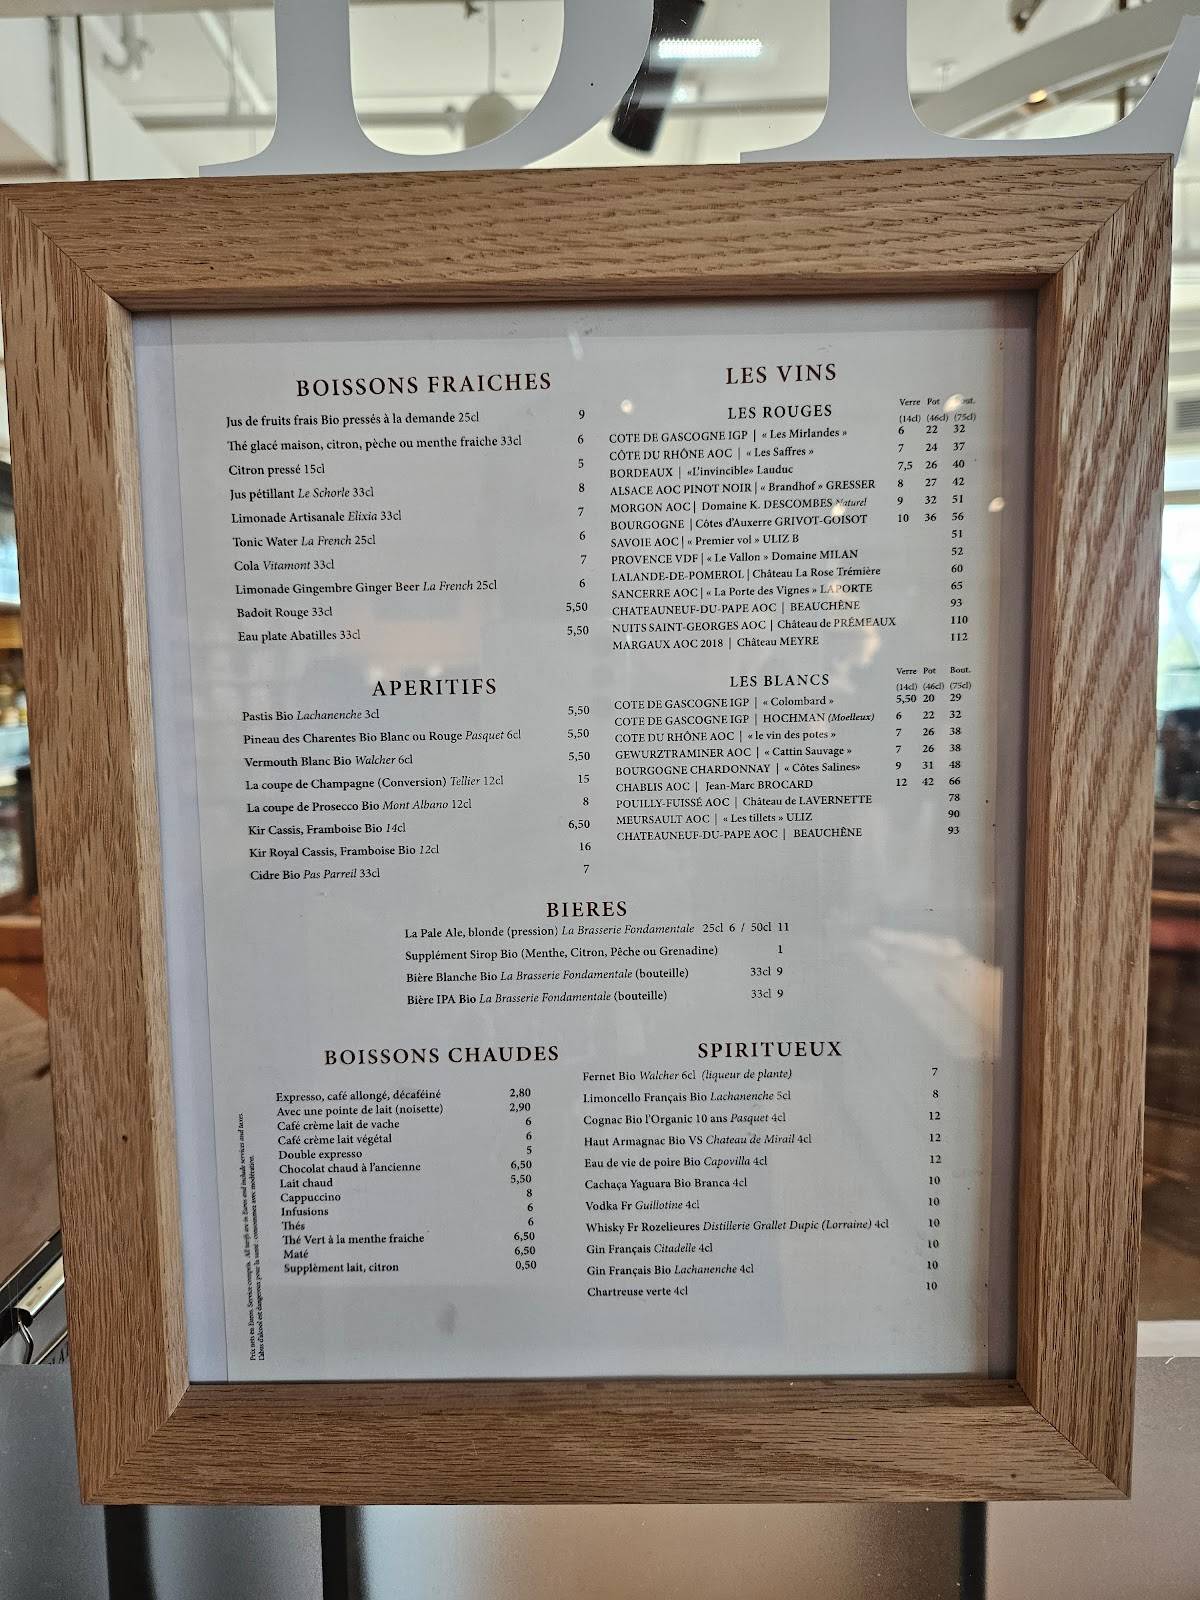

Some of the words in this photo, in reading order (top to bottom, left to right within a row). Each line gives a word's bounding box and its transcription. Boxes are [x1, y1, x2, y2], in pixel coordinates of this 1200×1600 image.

[726, 366, 767, 385] LES
[776, 363, 836, 383] VINS
[296, 376, 418, 397] BOISSONS
[427, 372, 551, 393] FRAICHES
[226, 416, 243, 429] Jus
[245, 415, 259, 427] de
[261, 415, 291, 426] fruits
[293, 414, 319, 426] frais
[320, 414, 340, 425] Bio
[342, 413, 381, 428] pressés
[383, 413, 390, 424] à
[392, 412, 403, 424] la
[405, 411, 456, 424] demande
[458, 411, 479, 423] 25cl
[578, 409, 585, 420] 9
[727, 406, 756, 420] LES
[762, 404, 832, 419] ROUGES
[228, 464, 265, 476] Citron
[267, 463, 301, 478] pressé
[304, 463, 325, 474] 15cl
[578, 458, 584, 469] 5
[231, 512, 287, 524] Limonade
[289, 511, 345, 523] Artisanale
[347, 510, 377, 522] Elixia
[380, 509, 402, 521] 33cl
[577, 506, 584, 517] 7
[234, 560, 261, 571] Cola
[262, 560, 311, 571] Vitamont
[313, 558, 335, 570] 33cl
[580, 554, 587, 565] 7
[612, 569, 745, 582] LALANDE-DE-POMEROL
[752, 568, 793, 579] Château
[795, 568, 808, 578] La
[810, 567, 834, 577] Rose
[836, 566, 881, 577] Trémière
[951, 563, 964, 574] 60
[236, 607, 273, 618] Badoit
[274, 607, 309, 620] Rouge
[312, 606, 333, 617] 33cl
[565, 602, 588, 613] 5,50
[612, 603, 750, 616] CHATEAUNEUF-DU-PAPE
[751, 602, 777, 613] AOC
[790, 599, 860, 611] BEAUCHÊNE
[950, 598, 963, 608] 93
[612, 639, 671, 650] MARGAUX
[673, 639, 698, 649] AOC
[700, 638, 724, 648] 2018
[736, 637, 777, 647] Château
[779, 636, 819, 646] MEYRE
[951, 632, 968, 642] 112
[896, 667, 918, 675] Verre
[923, 666, 937, 675] Pot
[371, 678, 496, 697] APERITIFS
[730, 675, 758, 688] LES
[763, 673, 829, 687] BLANCS
[242, 711, 273, 721] Pastis
[275, 711, 294, 721] Bio
[296, 709, 362, 721] Lachanenche
[364, 708, 380, 719] 3cl
[568, 705, 590, 717] 5,50
[244, 756, 299, 767] Vermouth
[300, 756, 331, 767] Blanc
[333, 753, 352, 766] Bio
[355, 754, 396, 765] Walcher
[398, 754, 413, 765] 6cl
[568, 751, 591, 762] 5,50
[615, 782, 663, 792] CHABLIS
[665, 781, 690, 792] AOC
[705, 780, 755, 792] Jean-Marc
[757, 779, 813, 790] BROCARD
[896, 777, 908, 787] 12
[921, 777, 935, 786] 42
[948, 776, 961, 786] 66
[616, 796, 703, 809] POUILLY-FUISSÉ
[704, 794, 730, 807] AOC
[742, 796, 783, 806] Château
[784, 796, 797, 806] de
[799, 794, 872, 805] LAVERNETTE
[948, 793, 961, 802] 78
[250, 870, 280, 881] Cidre
[282, 870, 301, 880] Bio
[303, 869, 321, 880] Pas
[323, 868, 357, 879] Parreil
[359, 867, 381, 878] 33cl
[583, 864, 590, 874] 7
[546, 900, 627, 918] BIERES
[405, 950, 467, 963] Supplément
[469, 949, 498, 962] Sirop
[500, 948, 518, 959] Bio
[521, 946, 568, 960] (Menthe,
[568, 945, 608, 959] Citron,
[609, 945, 641, 957] Pêche
[641, 943, 657, 958] ou
[658, 945, 718, 956] Grenadine)
[778, 944, 783, 954] 1
[406, 972, 434, 983] Bière
[436, 971, 477, 982] Blanche
[479, 971, 498, 982] Bio
[500, 971, 513, 981] La
[515, 970, 561, 981] Brasserie
[562, 968, 633, 980] Fondamentale
[635, 967, 689, 981] (bouteille)
[750, 966, 771, 977] 33cl
[776, 966, 783, 976] 9
[325, 1048, 439, 1065] BOISSONS
[448, 1045, 559, 1063] CHAUDES
[698, 1041, 842, 1059] SPIRITUEUX
[276, 1092, 325, 1105] Expresso,
[326, 1090, 348, 1101] café
[350, 1090, 391, 1103] allongé,
[392, 1089, 441, 1100] décaféiné
[509, 1087, 531, 1099] 2,80
[583, 1092, 641, 1103] Limoncello
[643, 1092, 689, 1105] Français
[689, 1092, 707, 1102] Bio
[710, 1090, 774, 1101] Lachanenche
[776, 1090, 791, 1100] 5cl
[932, 1089, 939, 1099] 8
[278, 1149, 316, 1160] Double
[318, 1151, 363, 1162] expresso
[526, 1145, 532, 1155] 5
[280, 1178, 300, 1188] Lait
[302, 1177, 333, 1188] chaud
[510, 1174, 532, 1185] 5,50
[584, 1179, 628, 1192] Cachaça
[629, 1179, 671, 1192] Yaguara
[673, 1178, 692, 1188] Bio
[694, 1178, 730, 1188] Branca
[732, 1177, 747, 1187] 4cl
[929, 1175, 941, 1185] 10
[280, 1192, 341, 1205] Cappuccino
[526, 1188, 533, 1198] 8
[585, 1200, 618, 1211] Vodka
[621, 1200, 633, 1211] Fr
[634, 1199, 683, 1211] Guillotine
[685, 1199, 700, 1209] 4cl
[928, 1197, 940, 1207] 10
[281, 1220, 306, 1231] Thés
[527, 1216, 534, 1227] 6
[283, 1249, 309, 1259] Maté
[514, 1245, 536, 1257] 6,50
[346, 1262, 366, 1273] lait,
[368, 1262, 399, 1272] citron
[515, 1260, 537, 1271] 0,50
[587, 1286, 644, 1297] Chartreuse
[646, 1287, 671, 1296] verte
[673, 1285, 688, 1296] 4cl
[926, 1281, 938, 1291] 10
